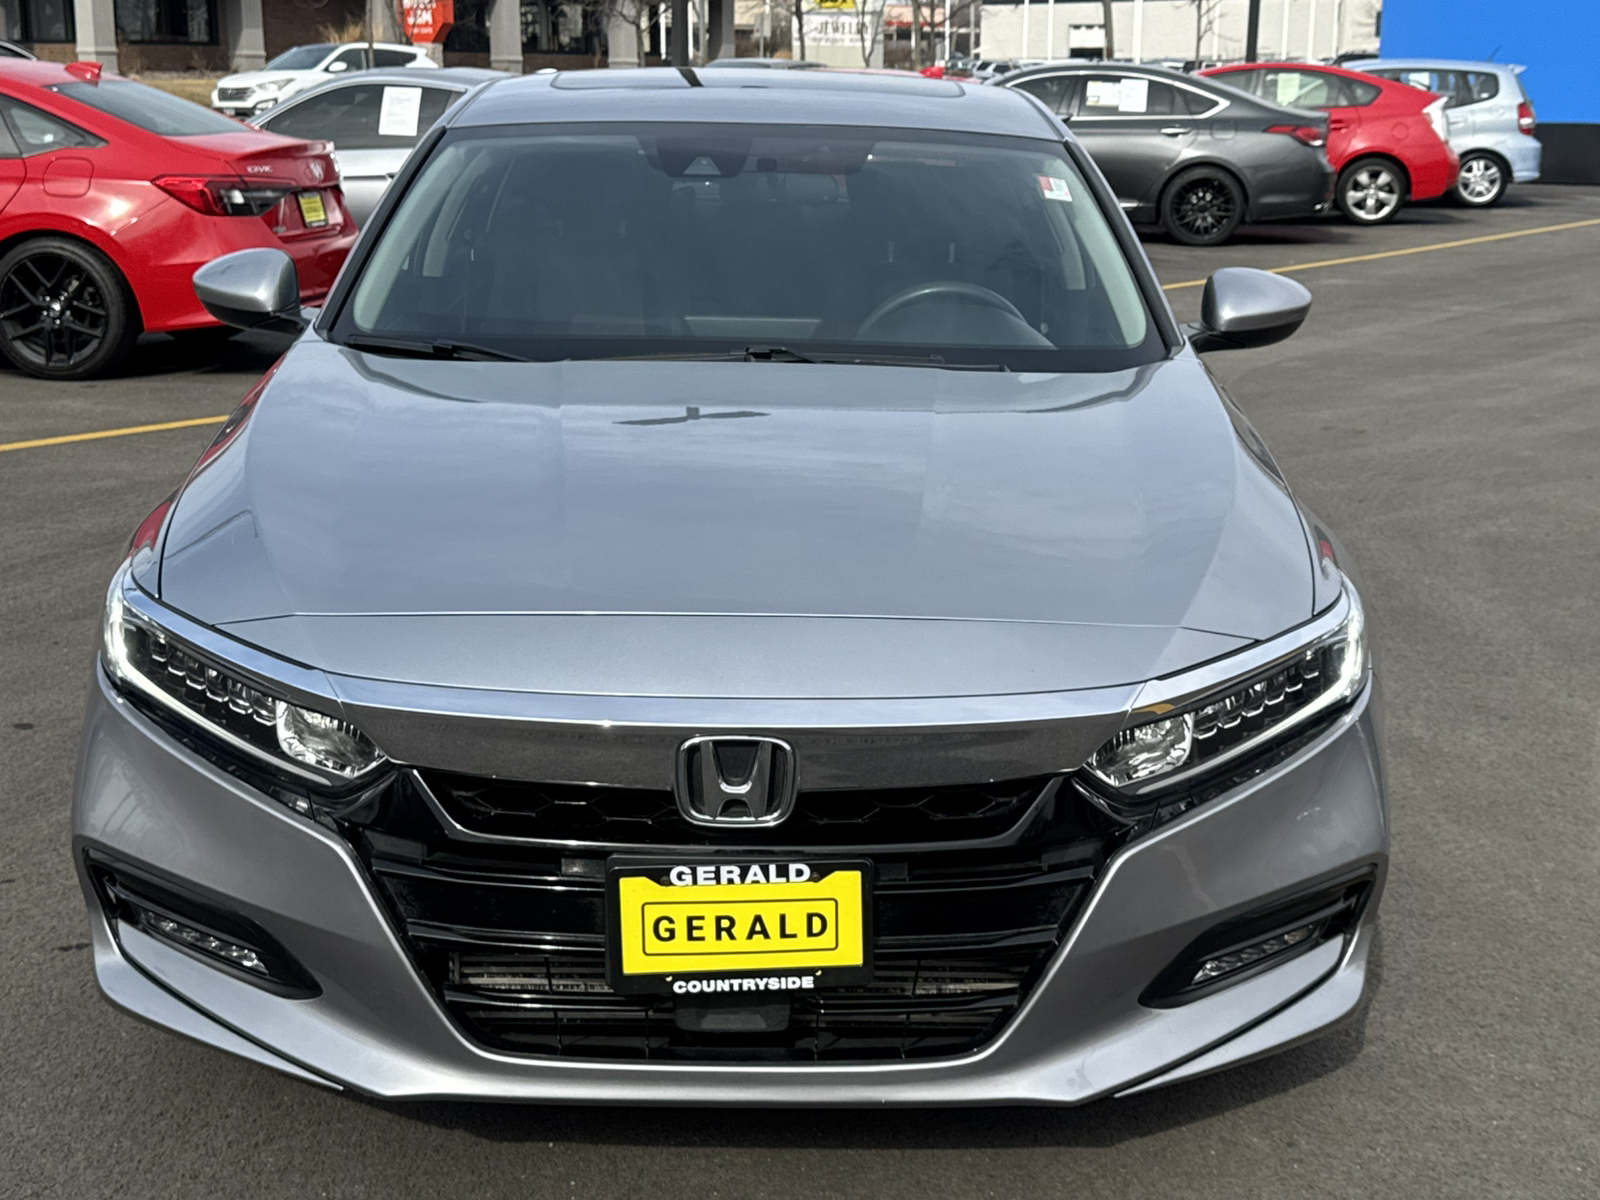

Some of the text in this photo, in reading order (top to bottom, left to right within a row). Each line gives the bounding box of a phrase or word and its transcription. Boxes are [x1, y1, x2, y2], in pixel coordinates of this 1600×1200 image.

[669, 863, 811, 887] GERALD
[652, 912, 828, 942] GERALD
[672, 976, 815, 994] COUNTRYSIDE
